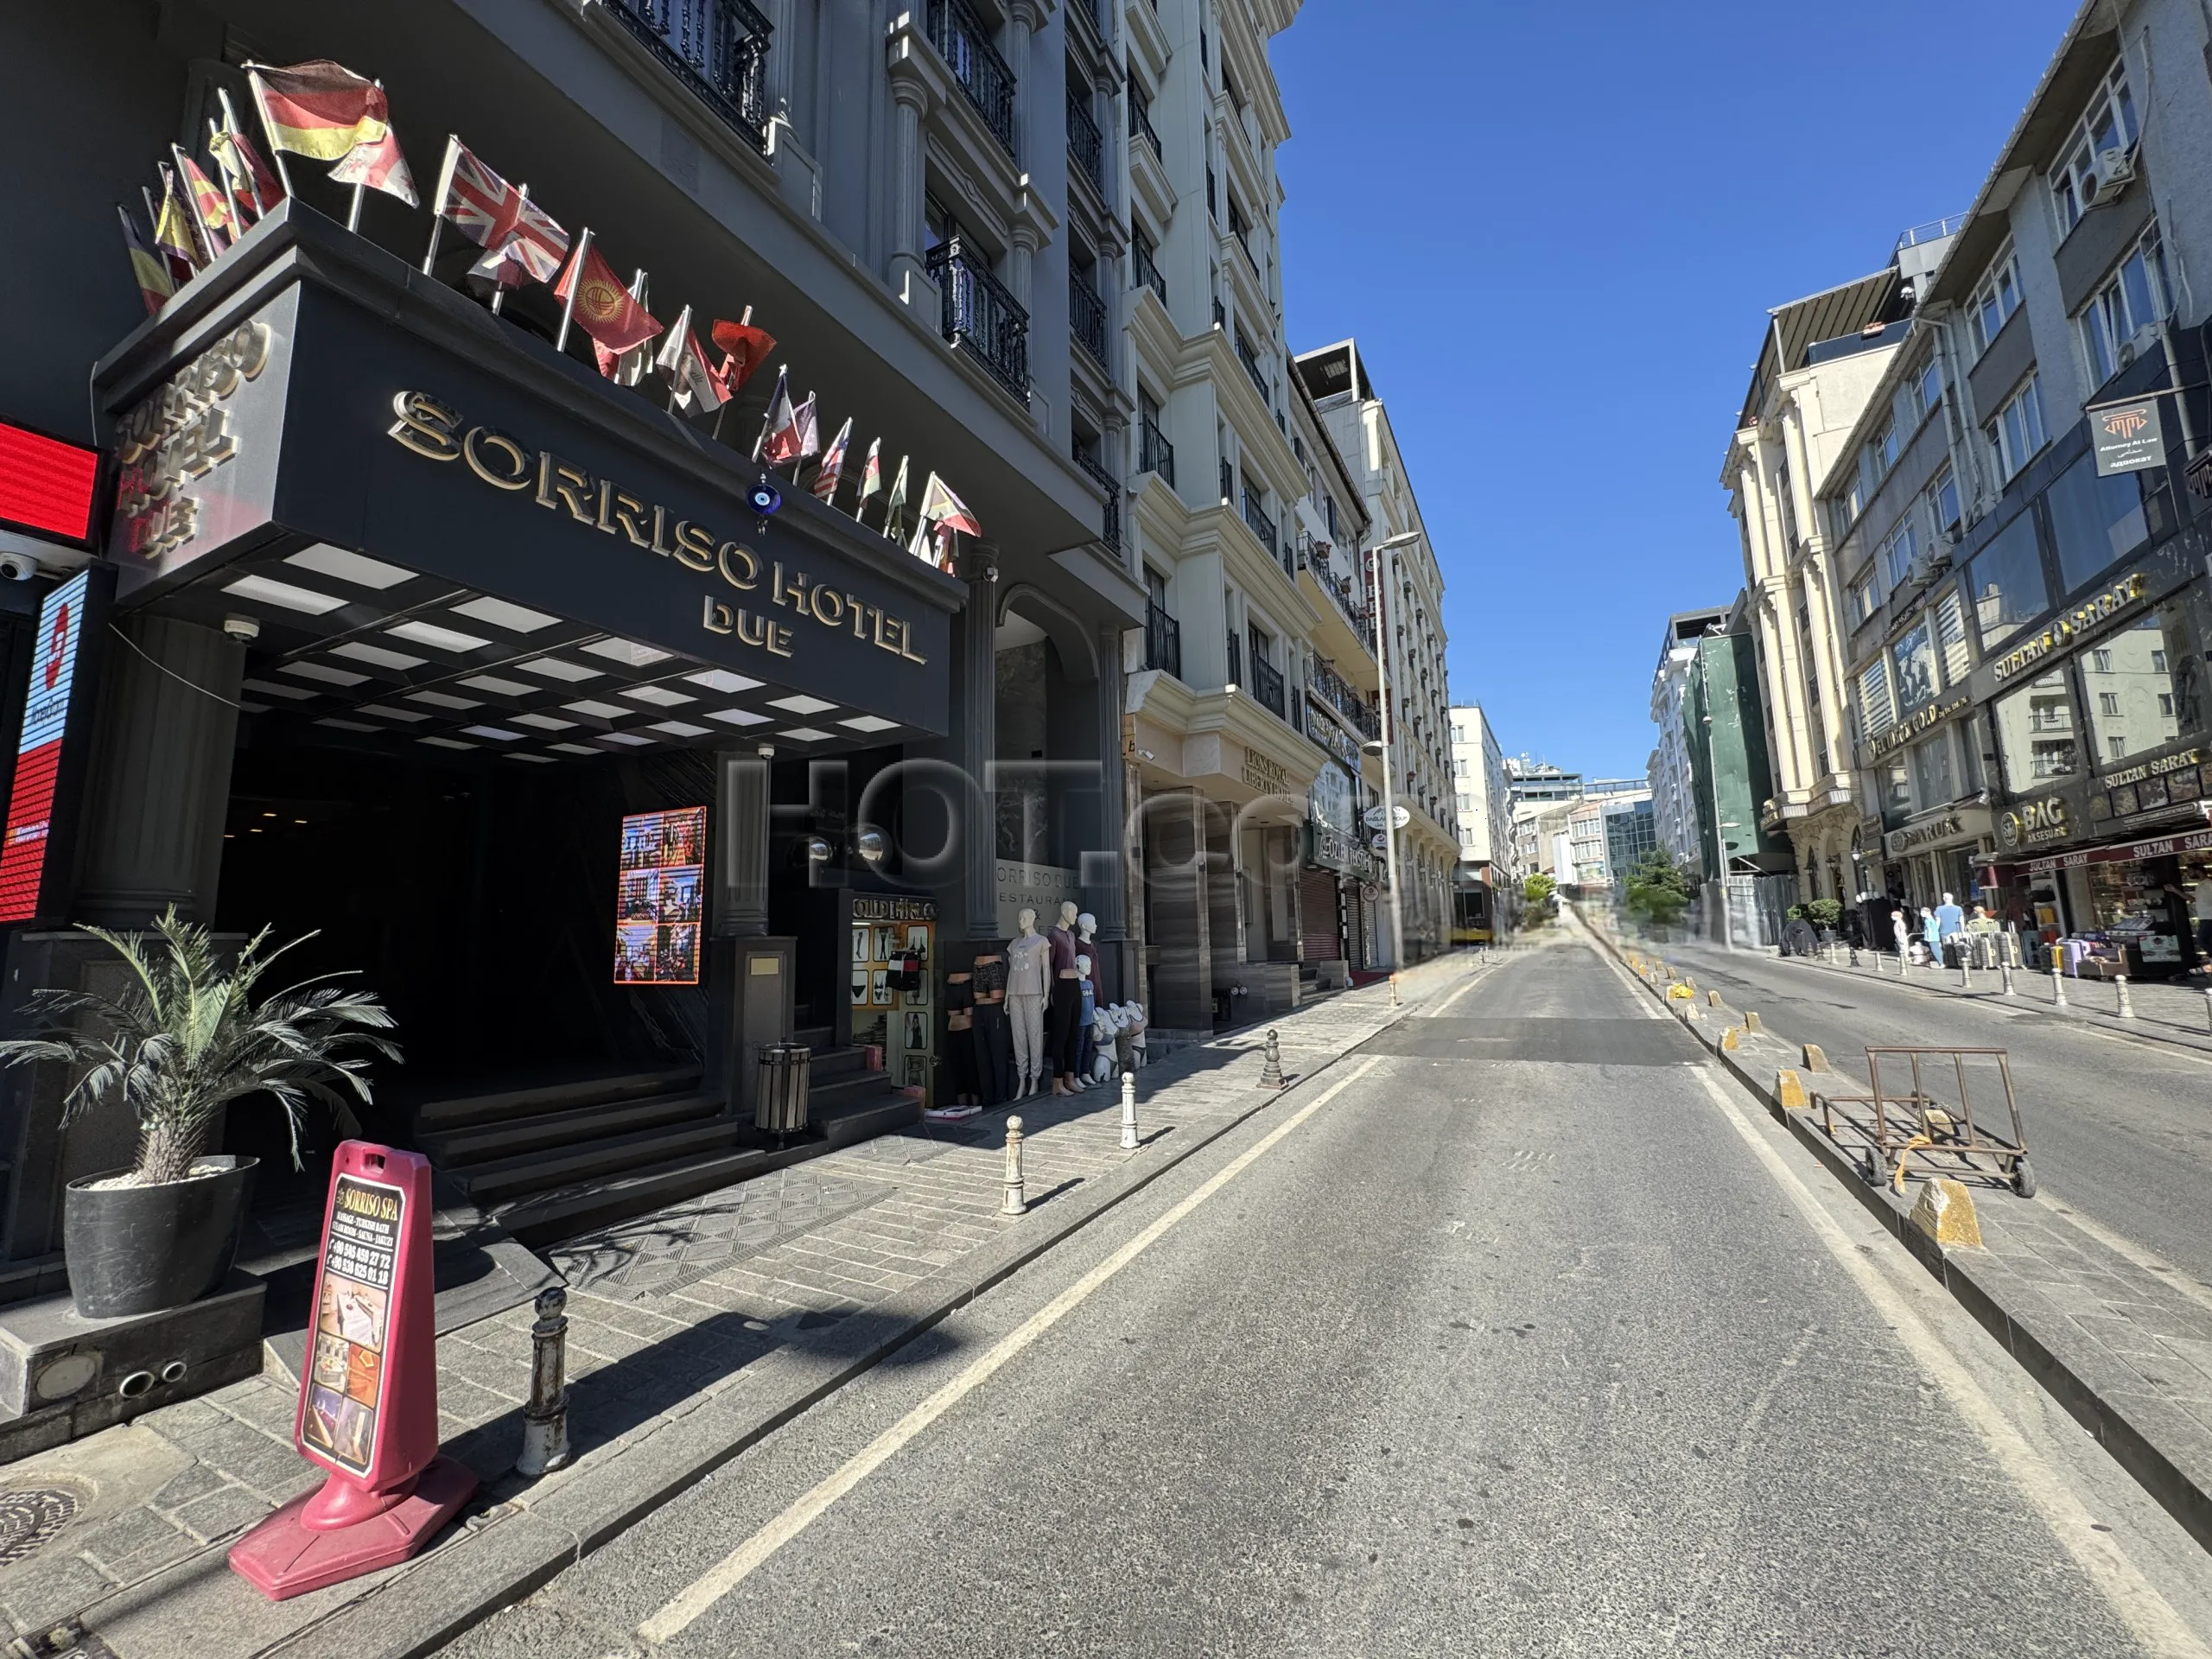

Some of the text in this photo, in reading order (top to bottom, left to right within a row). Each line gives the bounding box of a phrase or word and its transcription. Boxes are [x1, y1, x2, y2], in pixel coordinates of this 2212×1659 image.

[387, 390, 928, 665] SORRISO HOTEL
[703, 594, 796, 658] DUE
[1993, 574, 2145, 682] SULTAN SARAY
[2105, 748, 2199, 789] SULTAN SARAY
[2029, 853, 2088, 872] SULTAN SARAY
[2133, 840, 2174, 858] SULTAN
[344, 1187, 398, 1221] SORRISO SPA
[370, 1250, 380, 1267] 27
[380, 1254, 391, 1269] 72
